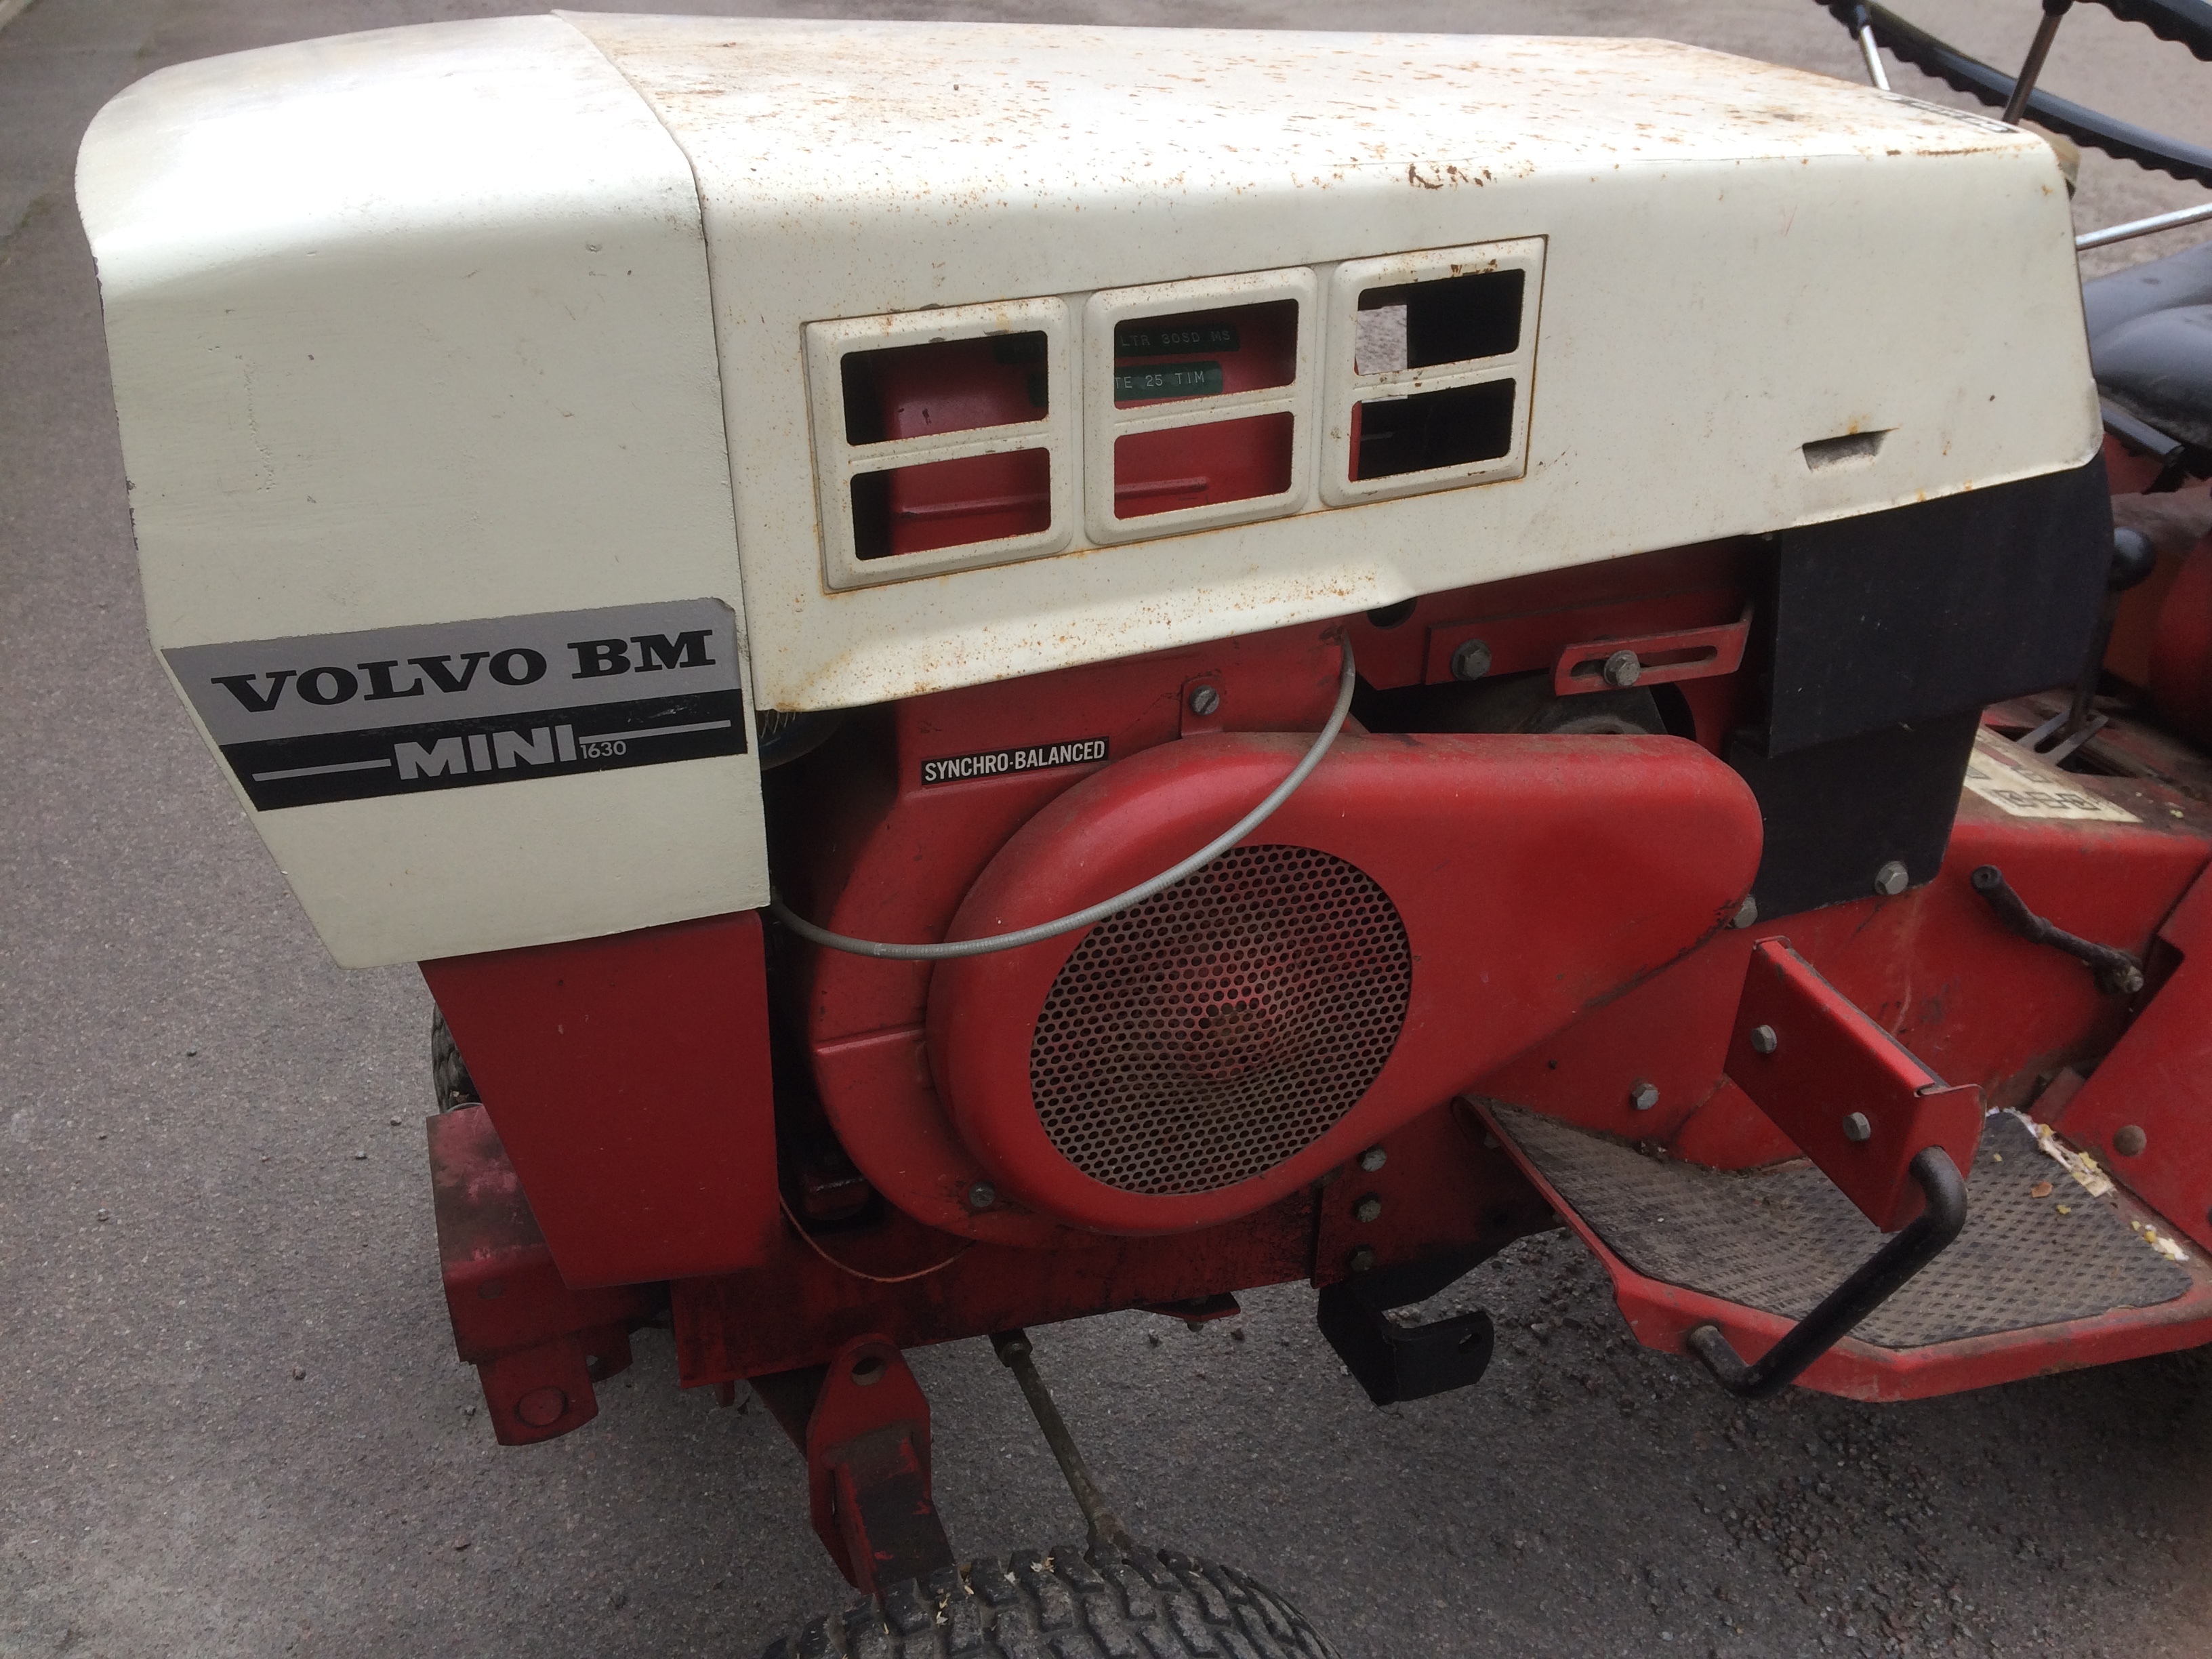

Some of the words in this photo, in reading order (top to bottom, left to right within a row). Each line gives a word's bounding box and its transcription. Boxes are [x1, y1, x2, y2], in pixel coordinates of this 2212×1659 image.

[1121, 335, 1150, 347] LTR
[1211, 330, 1230, 342] MS
[1114, 376, 1133, 389] TE
[1145, 374, 1163, 387] 25
[1174, 371, 1205, 385] TIM
[211, 648, 547, 712] VOLVO
[567, 630, 716, 679] BM
[394, 724, 577, 780] MINI
[580, 741, 627, 760] 1630
